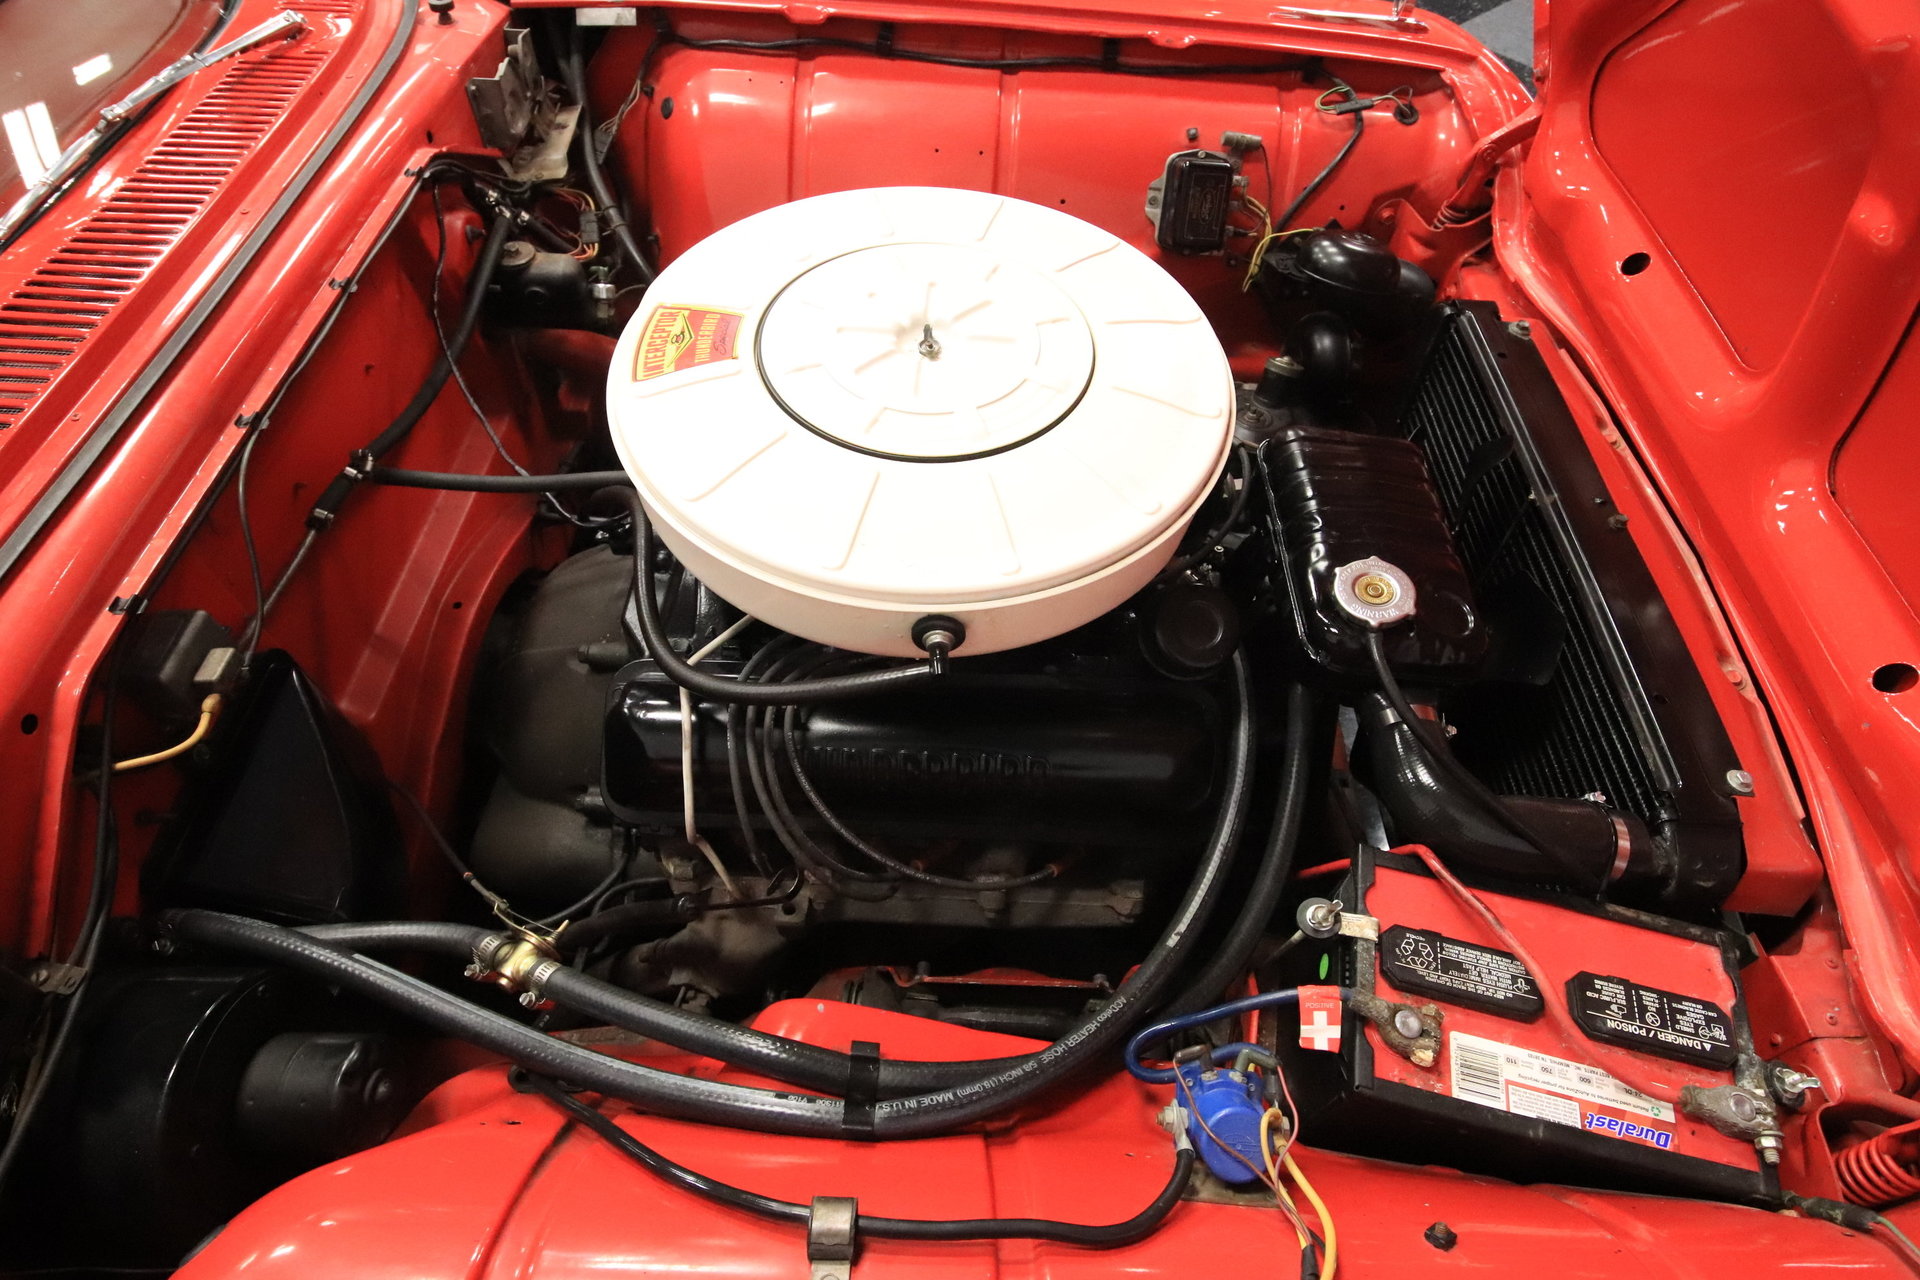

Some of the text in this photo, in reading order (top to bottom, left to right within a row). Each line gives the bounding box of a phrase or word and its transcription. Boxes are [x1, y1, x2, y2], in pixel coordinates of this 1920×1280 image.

[643, 310, 680, 377] INTERCEPTOR
[695, 313, 721, 363] THUNDERBIRD
[1349, 603, 1398, 619] WARNING
[1448, 969, 1511, 989] FLUSH EYES IMMEDIATELY
[1490, 969, 1510, 979] MEDICAL
[1096, 993, 1127, 1027] ACDelco
[1606, 1018, 1645, 1035] POISON
[1675, 1013, 1705, 1025] EXPLOSIVE
[1679, 1019, 1693, 1027] EYES
[1064, 1018, 1101, 1049] HEATER
[1657, 1031, 1700, 1048] DANGER
[1038, 1042, 1067, 1064] HOSE
[1021, 1058, 1037, 1072] 5/8
[1540, 1066, 1552, 1074] 750
[999, 1065, 1024, 1084] INCH
[1579, 1075, 1590, 1083] 600
[904, 1099, 917, 1109] IN
[919, 1091, 954, 1107] MADE
[1585, 1112, 1671, 1149] Duralast
